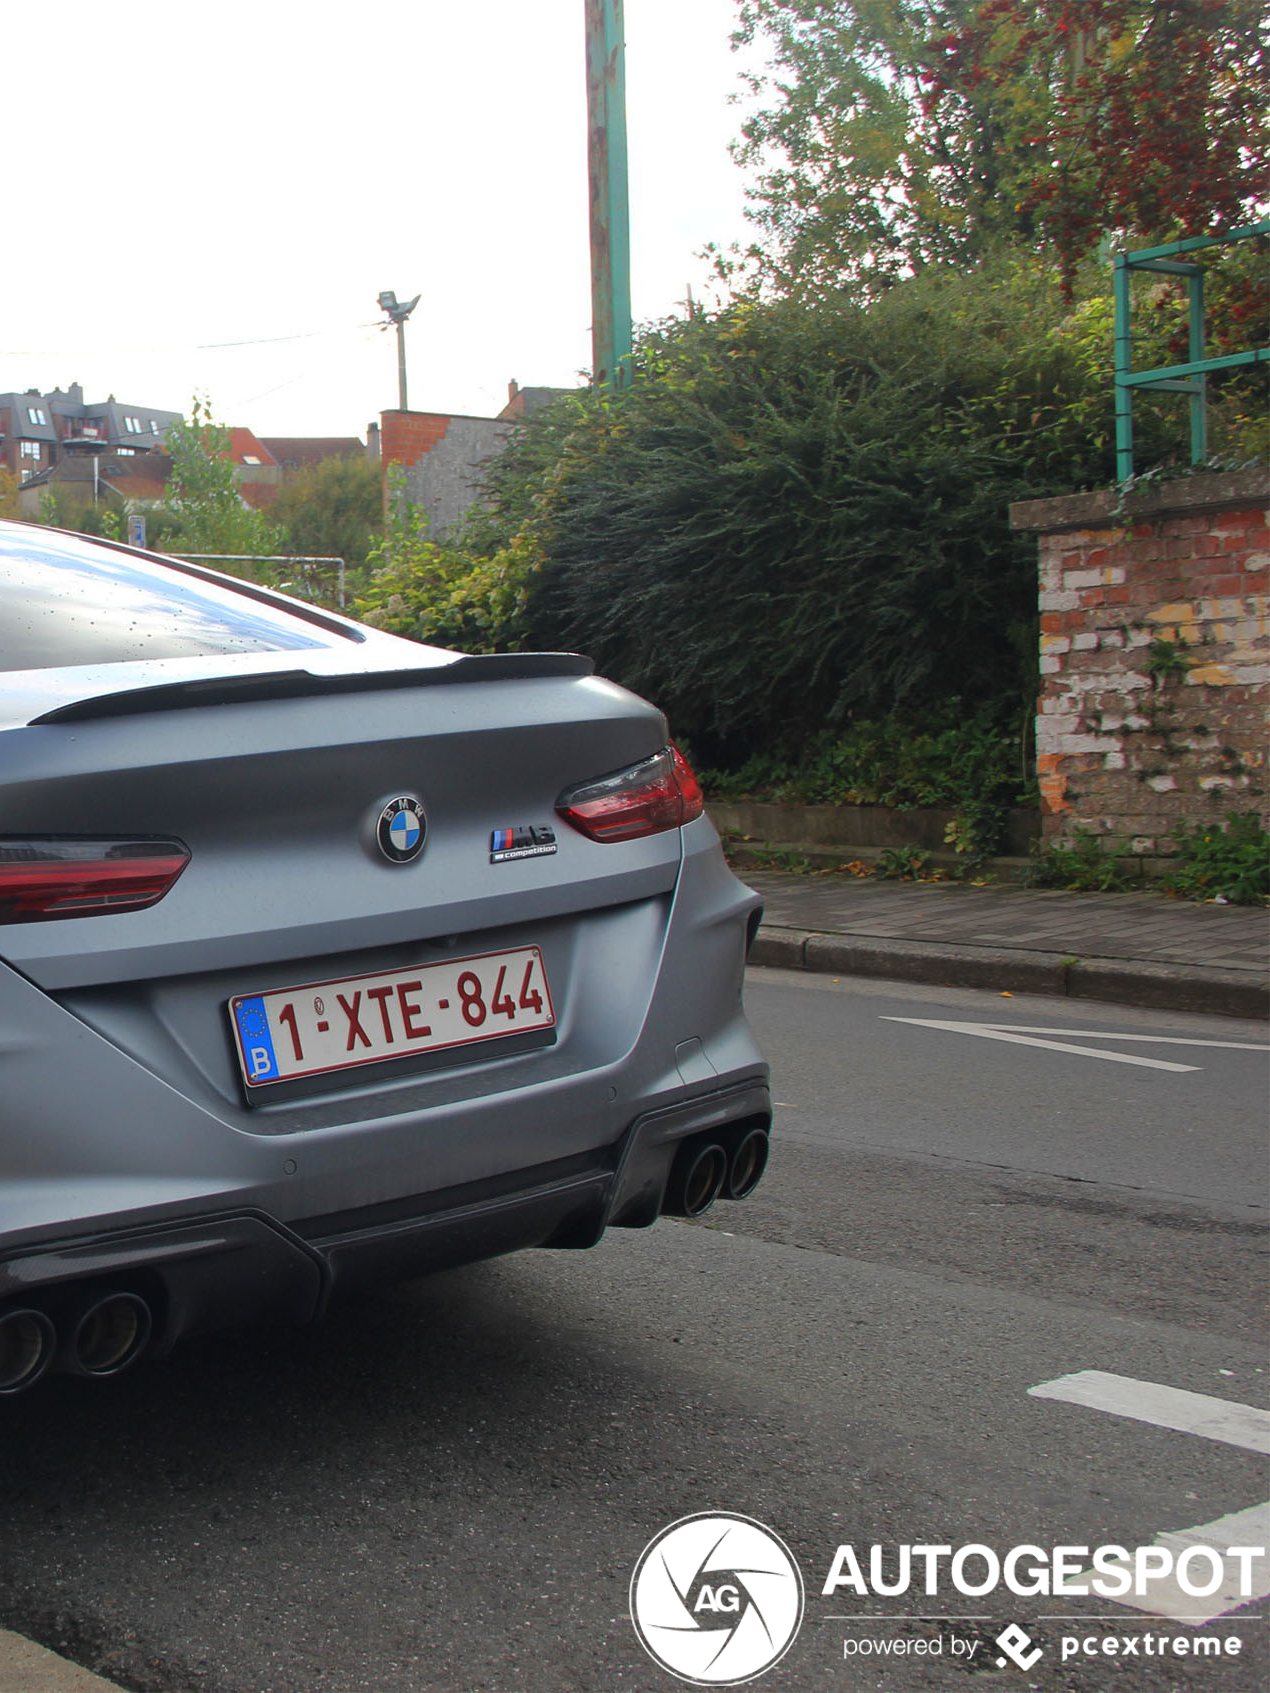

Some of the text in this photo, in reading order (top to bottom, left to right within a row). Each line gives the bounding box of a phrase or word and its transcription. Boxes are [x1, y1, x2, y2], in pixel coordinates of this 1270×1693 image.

[383, 798, 425, 822] BMW
[504, 845, 557, 858] competition
[279, 959, 544, 1062] 1-XTE-844
[250, 1047, 272, 1075] B
